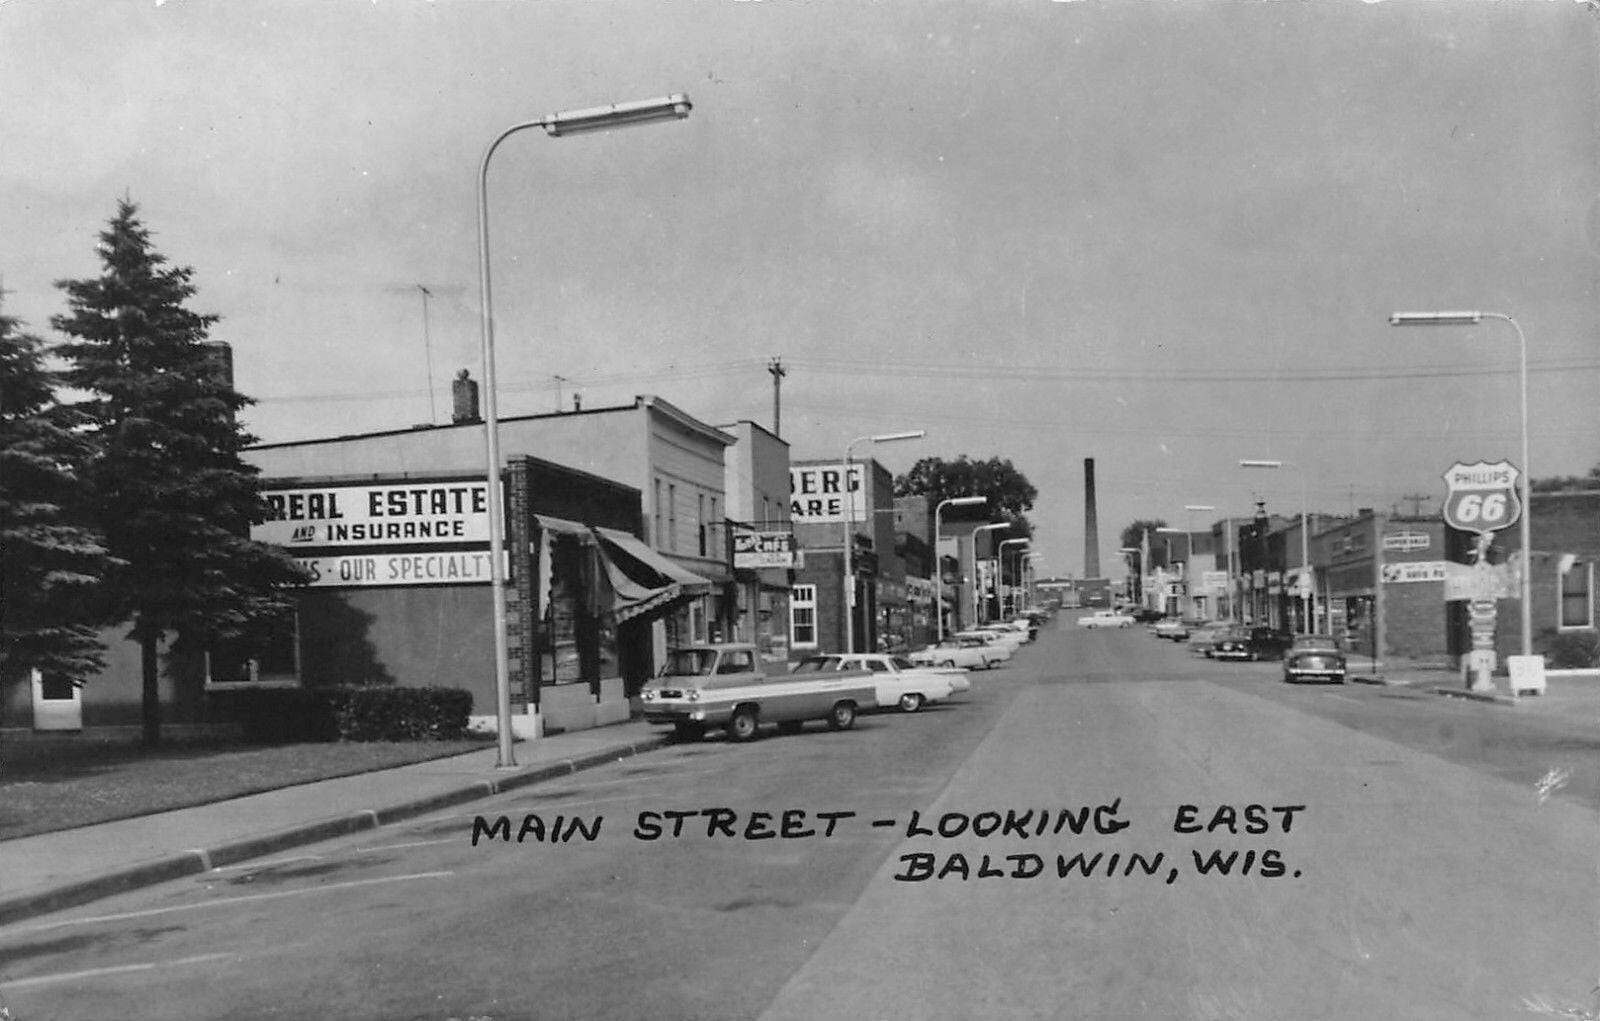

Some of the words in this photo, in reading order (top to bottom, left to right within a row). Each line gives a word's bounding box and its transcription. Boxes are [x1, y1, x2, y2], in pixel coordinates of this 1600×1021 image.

[1454, 471, 1509, 484] PHILLIPS
[266, 493, 343, 521] REAL
[368, 487, 487, 517] ESTATE
[1456, 493, 1507, 522] 66
[292, 525, 315, 540] AND
[327, 520, 465, 541] INSURANCE
[340, 558, 376, 580] OUR
